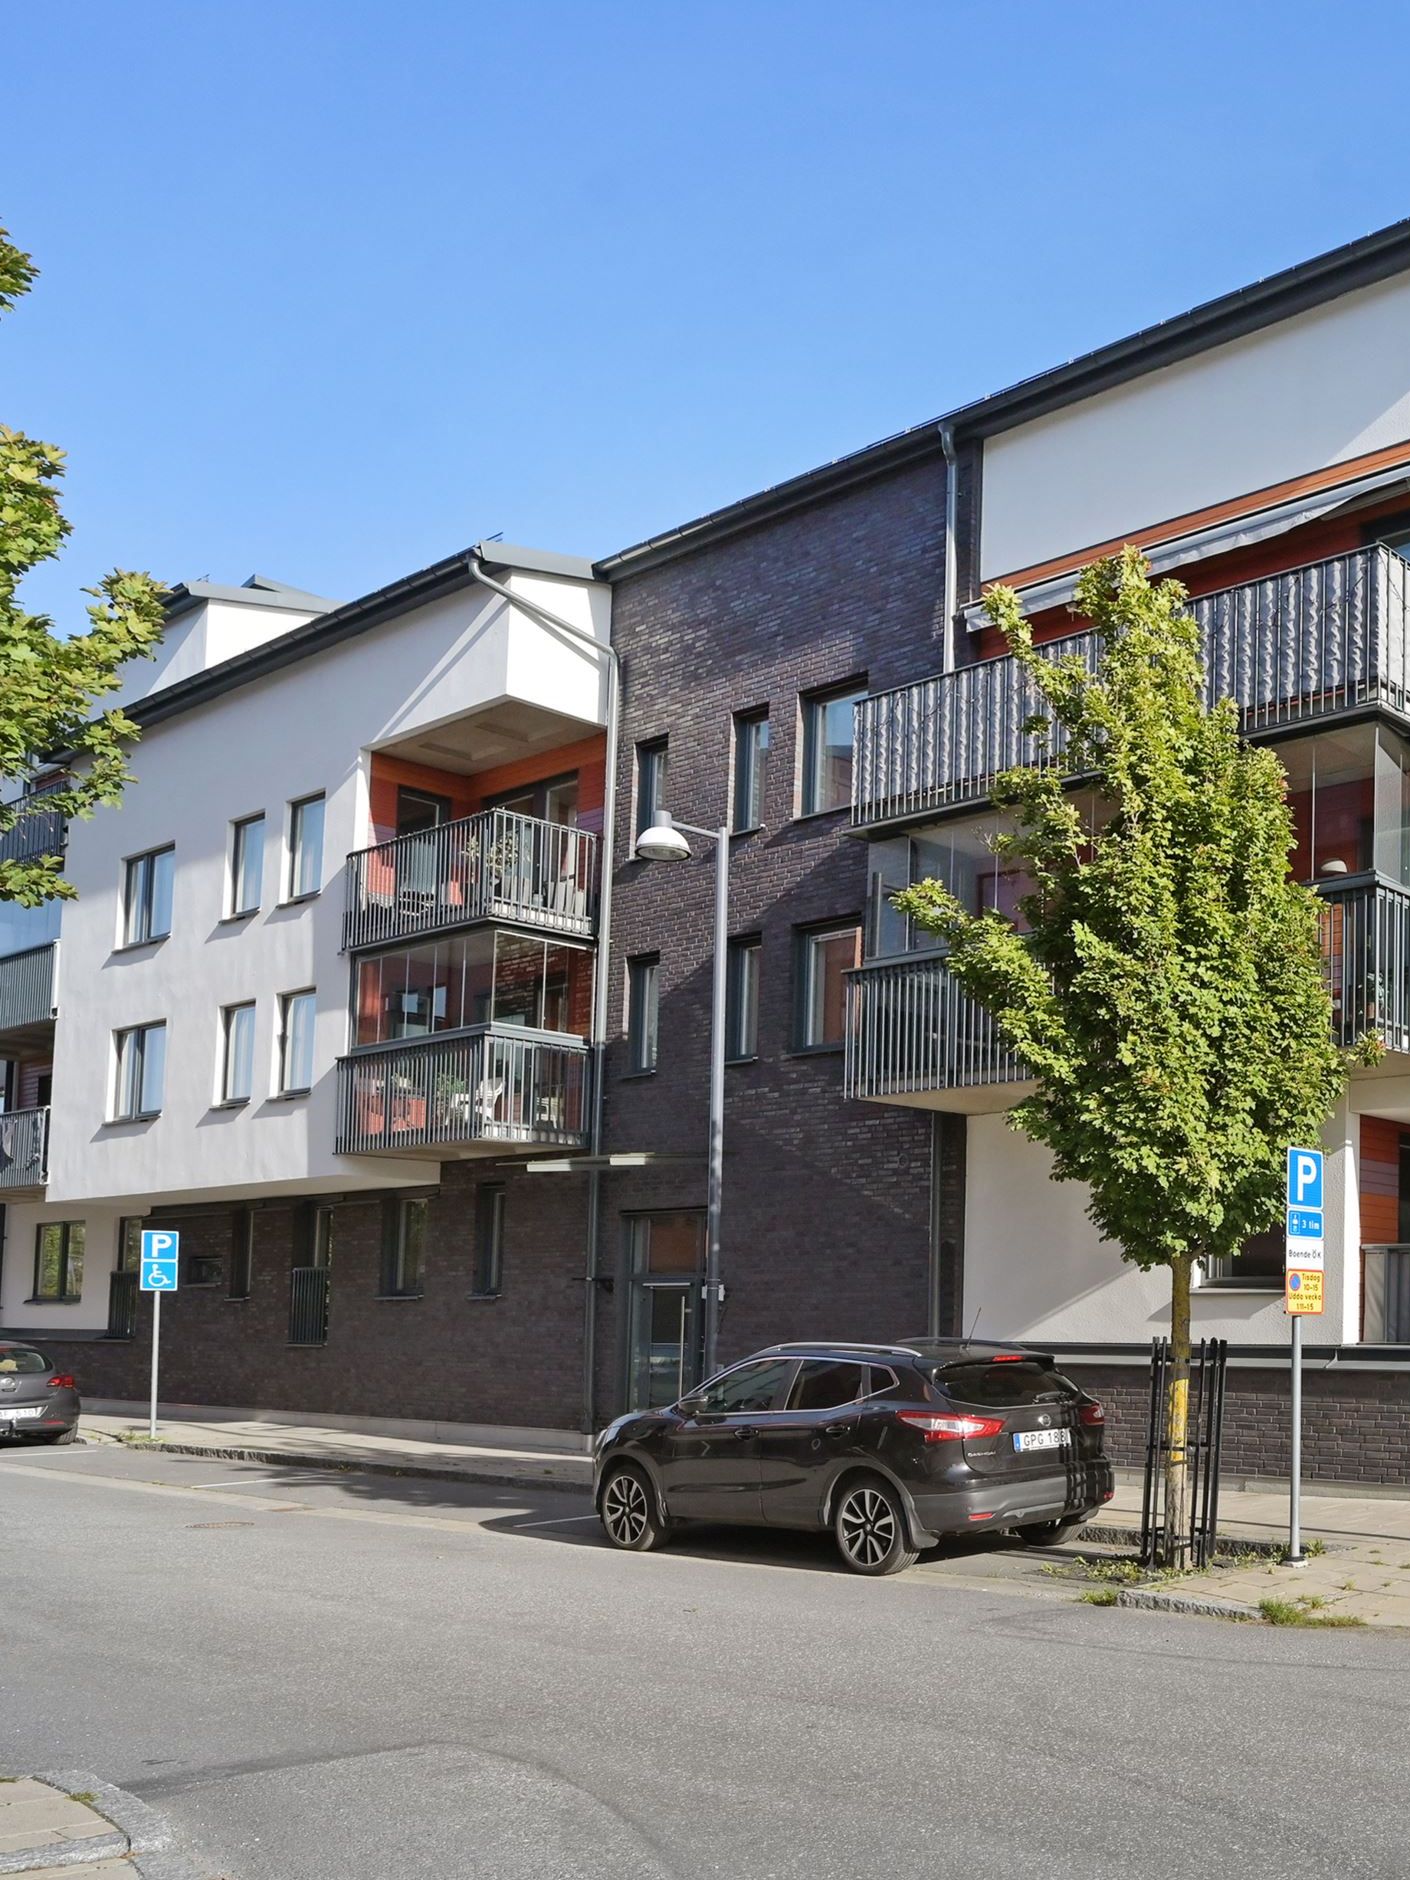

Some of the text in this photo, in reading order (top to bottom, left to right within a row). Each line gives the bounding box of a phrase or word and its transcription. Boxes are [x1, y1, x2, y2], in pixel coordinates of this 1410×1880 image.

[1297, 1155, 1317, 1201] P
[1301, 1219, 1320, 1230] 3 tim
[151, 1234, 172, 1258] P
[1288, 1249, 1311, 1258] Boende
[1302, 1273, 1320, 1283] Tisdag
[1289, 1292, 1321, 1300] Udda vecka
[1023, 1433, 1044, 1447] GPG
